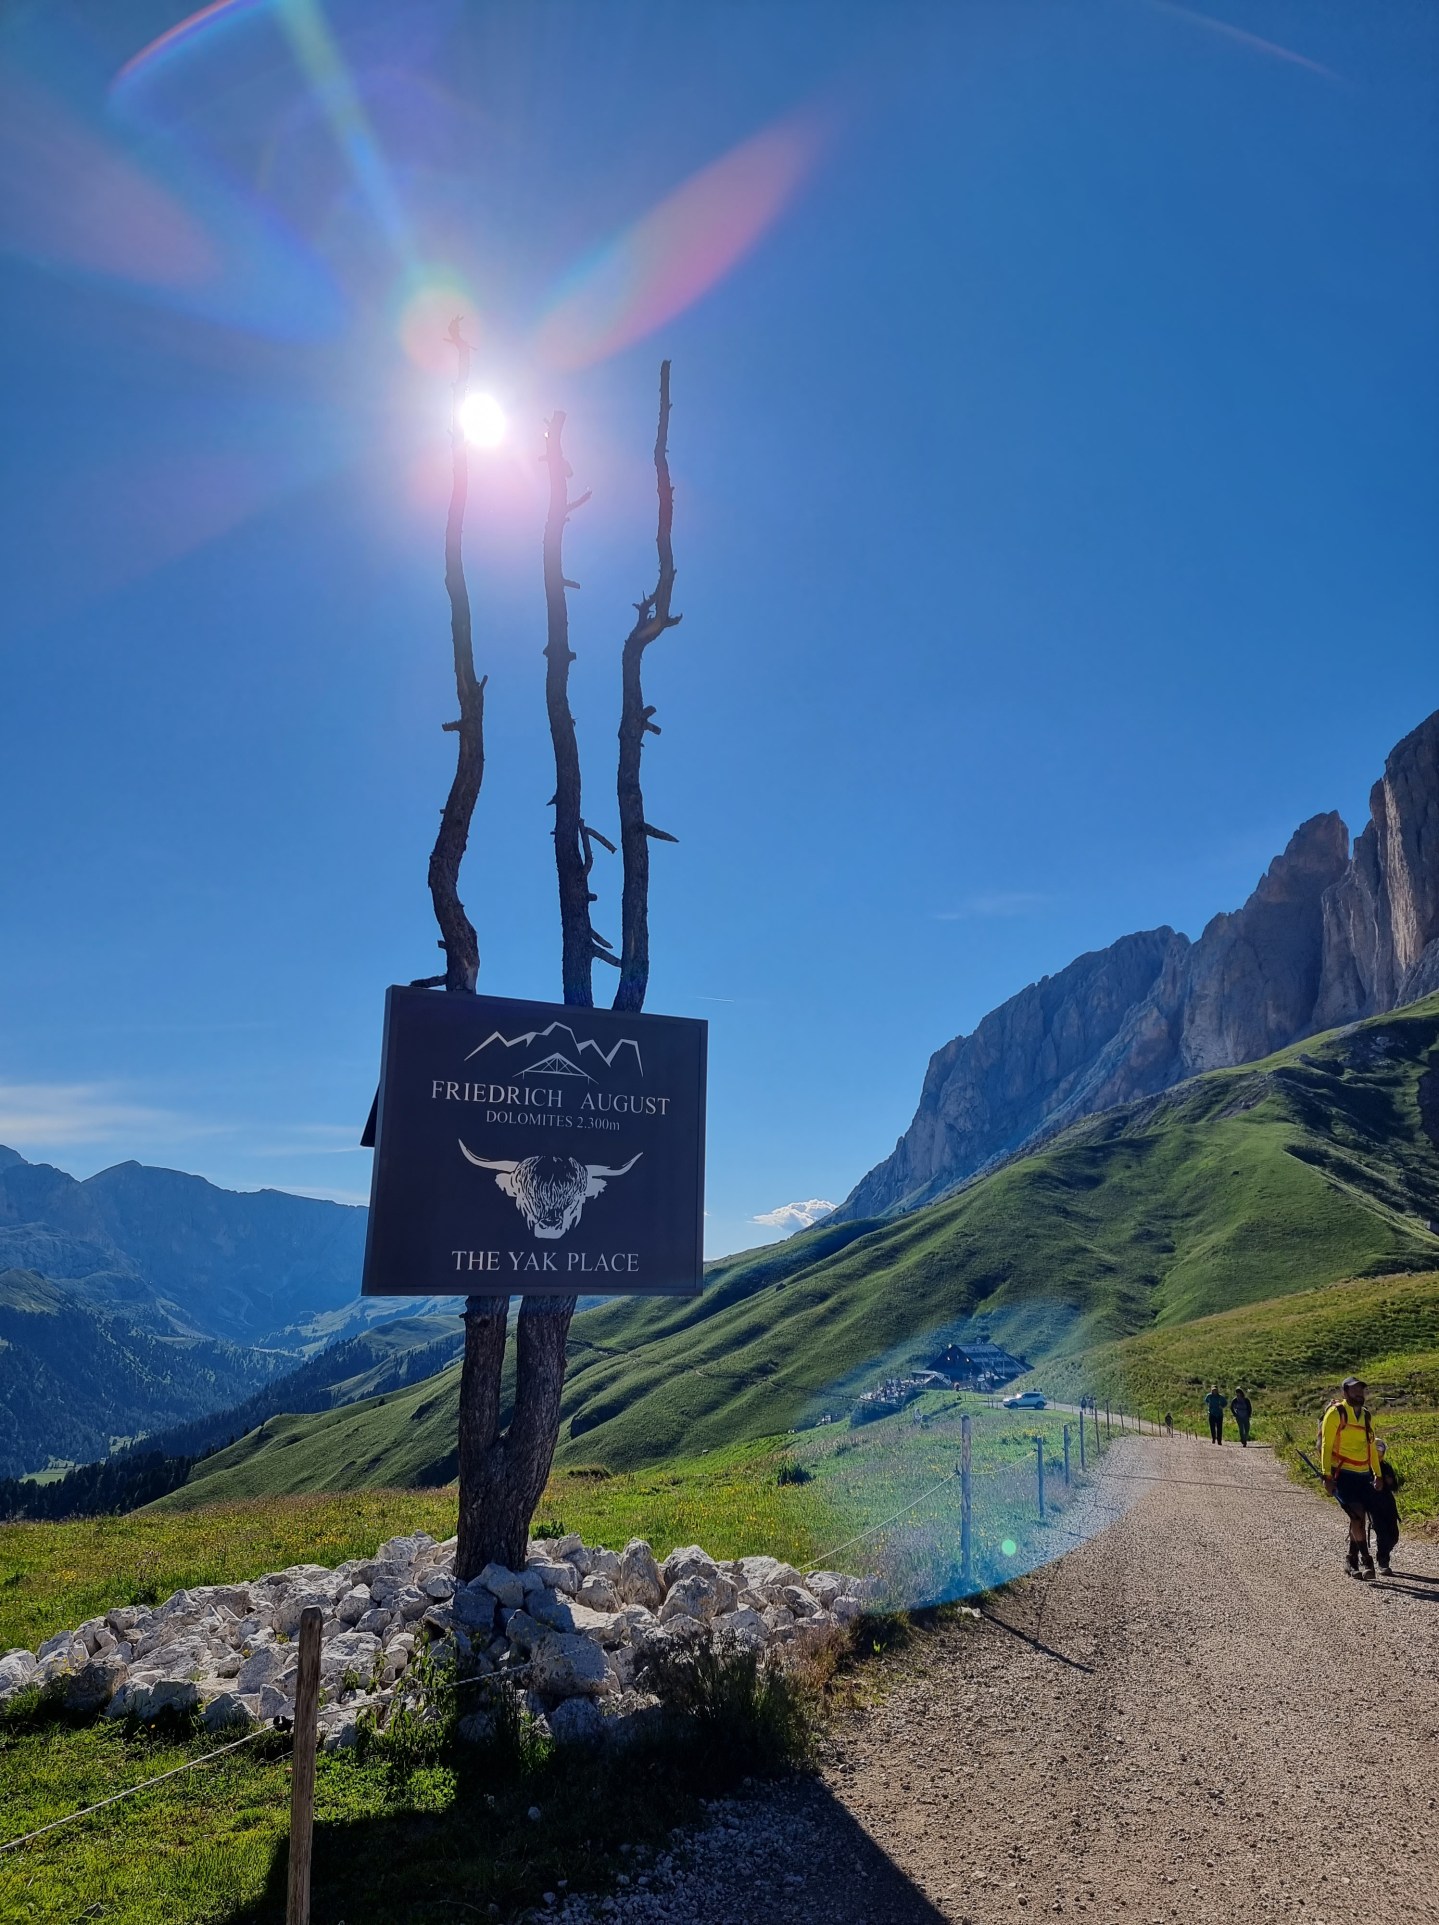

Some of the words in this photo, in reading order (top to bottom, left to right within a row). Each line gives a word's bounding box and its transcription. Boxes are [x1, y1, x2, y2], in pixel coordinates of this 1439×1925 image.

[431, 1080, 563, 1108] FRIEDRICH
[581, 1093, 671, 1116] AUGUST
[486, 1110, 573, 1128] DOLOMITES
[577, 1116, 620, 1131] 2.300m
[452, 1251, 500, 1271] THE
[508, 1252, 558, 1272] YAK
[567, 1253, 640, 1273] PLACE
